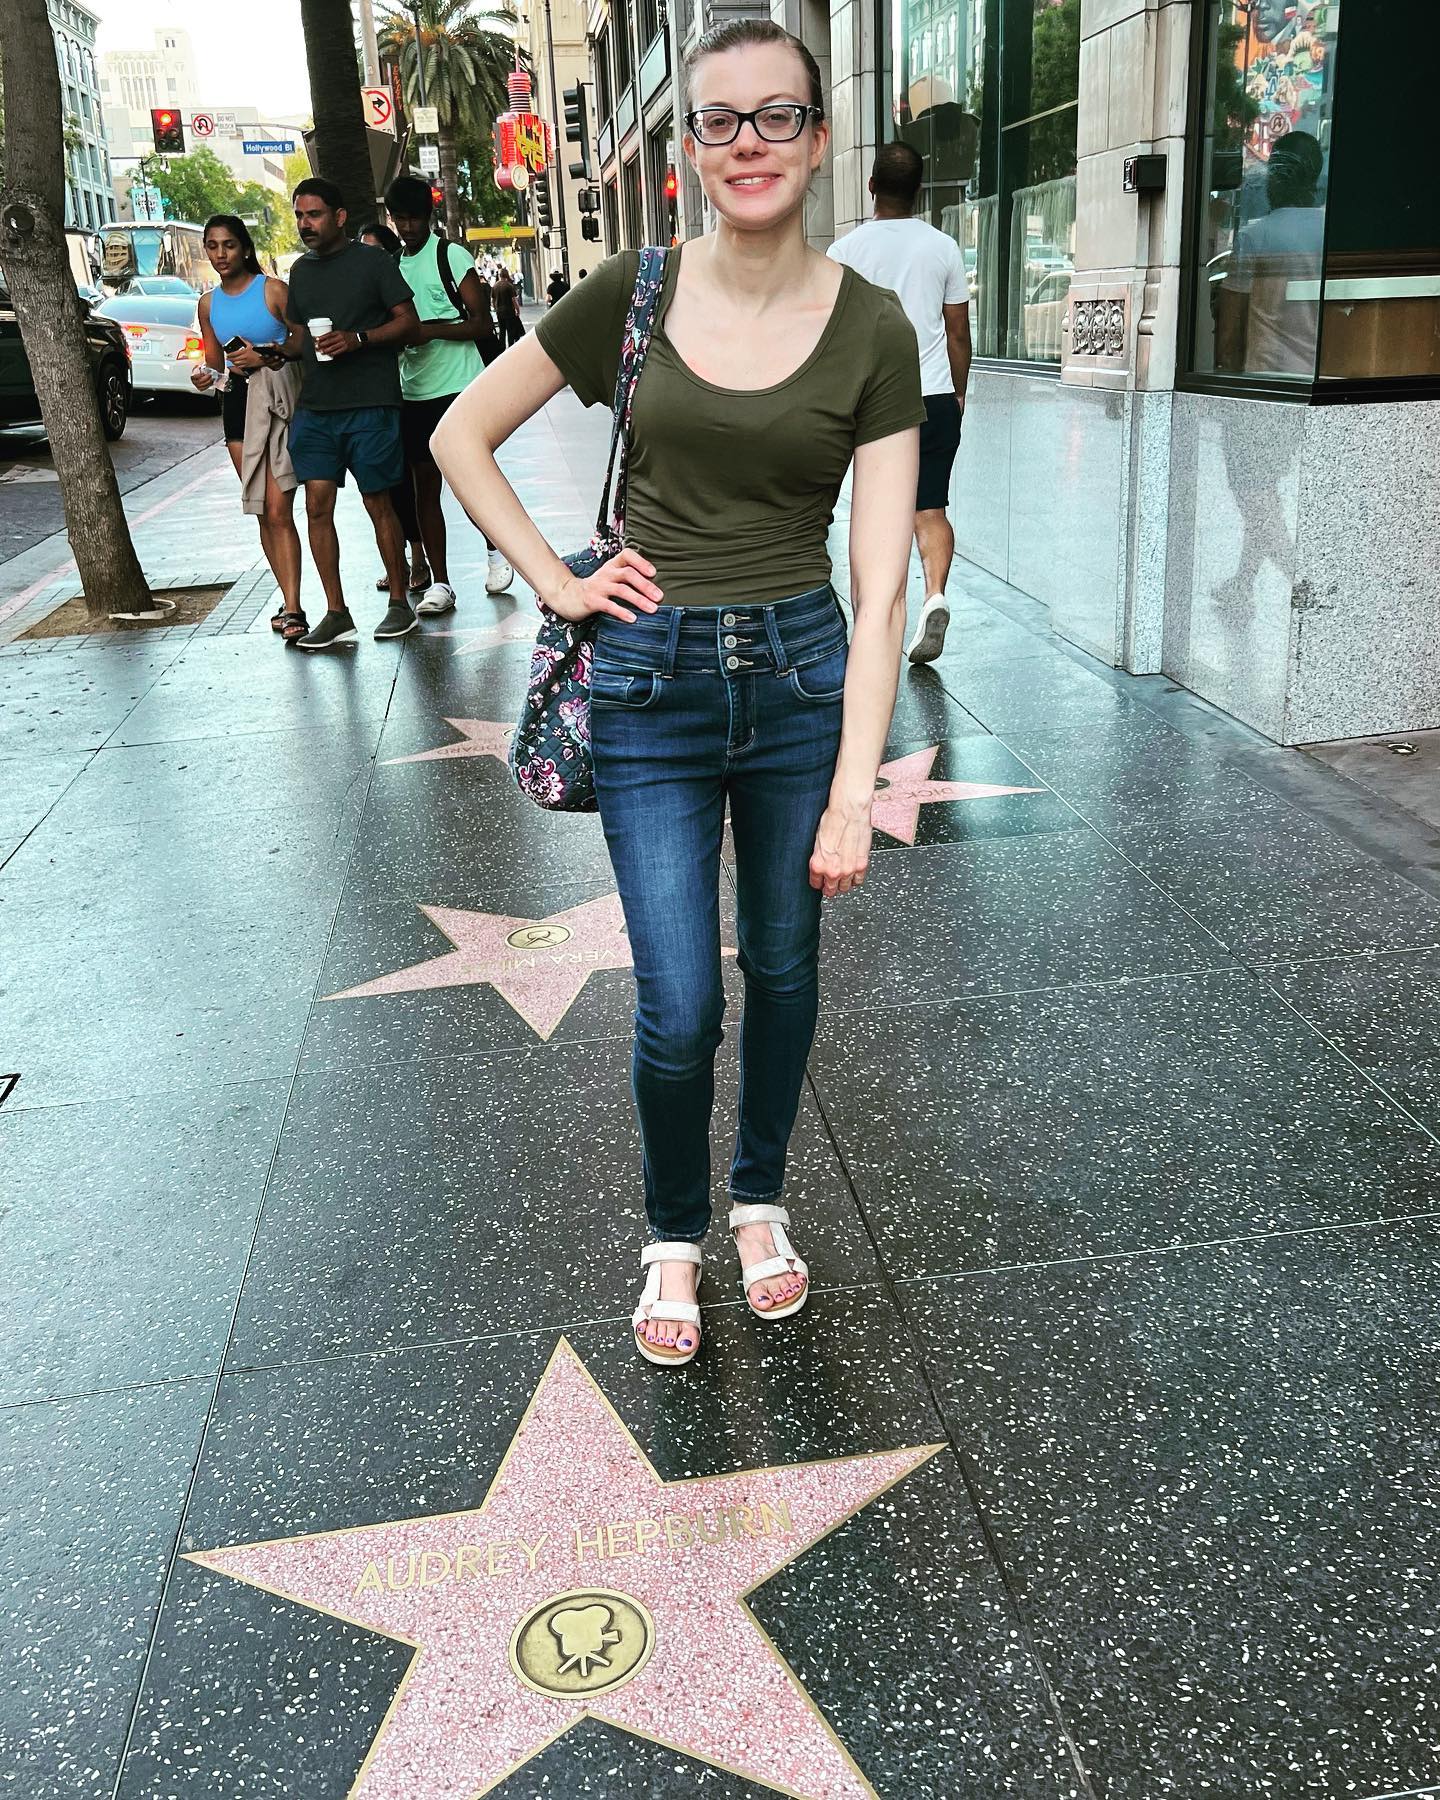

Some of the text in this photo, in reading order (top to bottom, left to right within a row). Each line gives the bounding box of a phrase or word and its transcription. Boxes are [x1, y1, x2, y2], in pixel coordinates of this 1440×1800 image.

[245, 143, 283, 154] Hollywood
[904, 787, 954, 799] DICK
[549, 949, 616, 965] VERA
[351, 1498, 794, 1598] AUDREY HEPBURN
